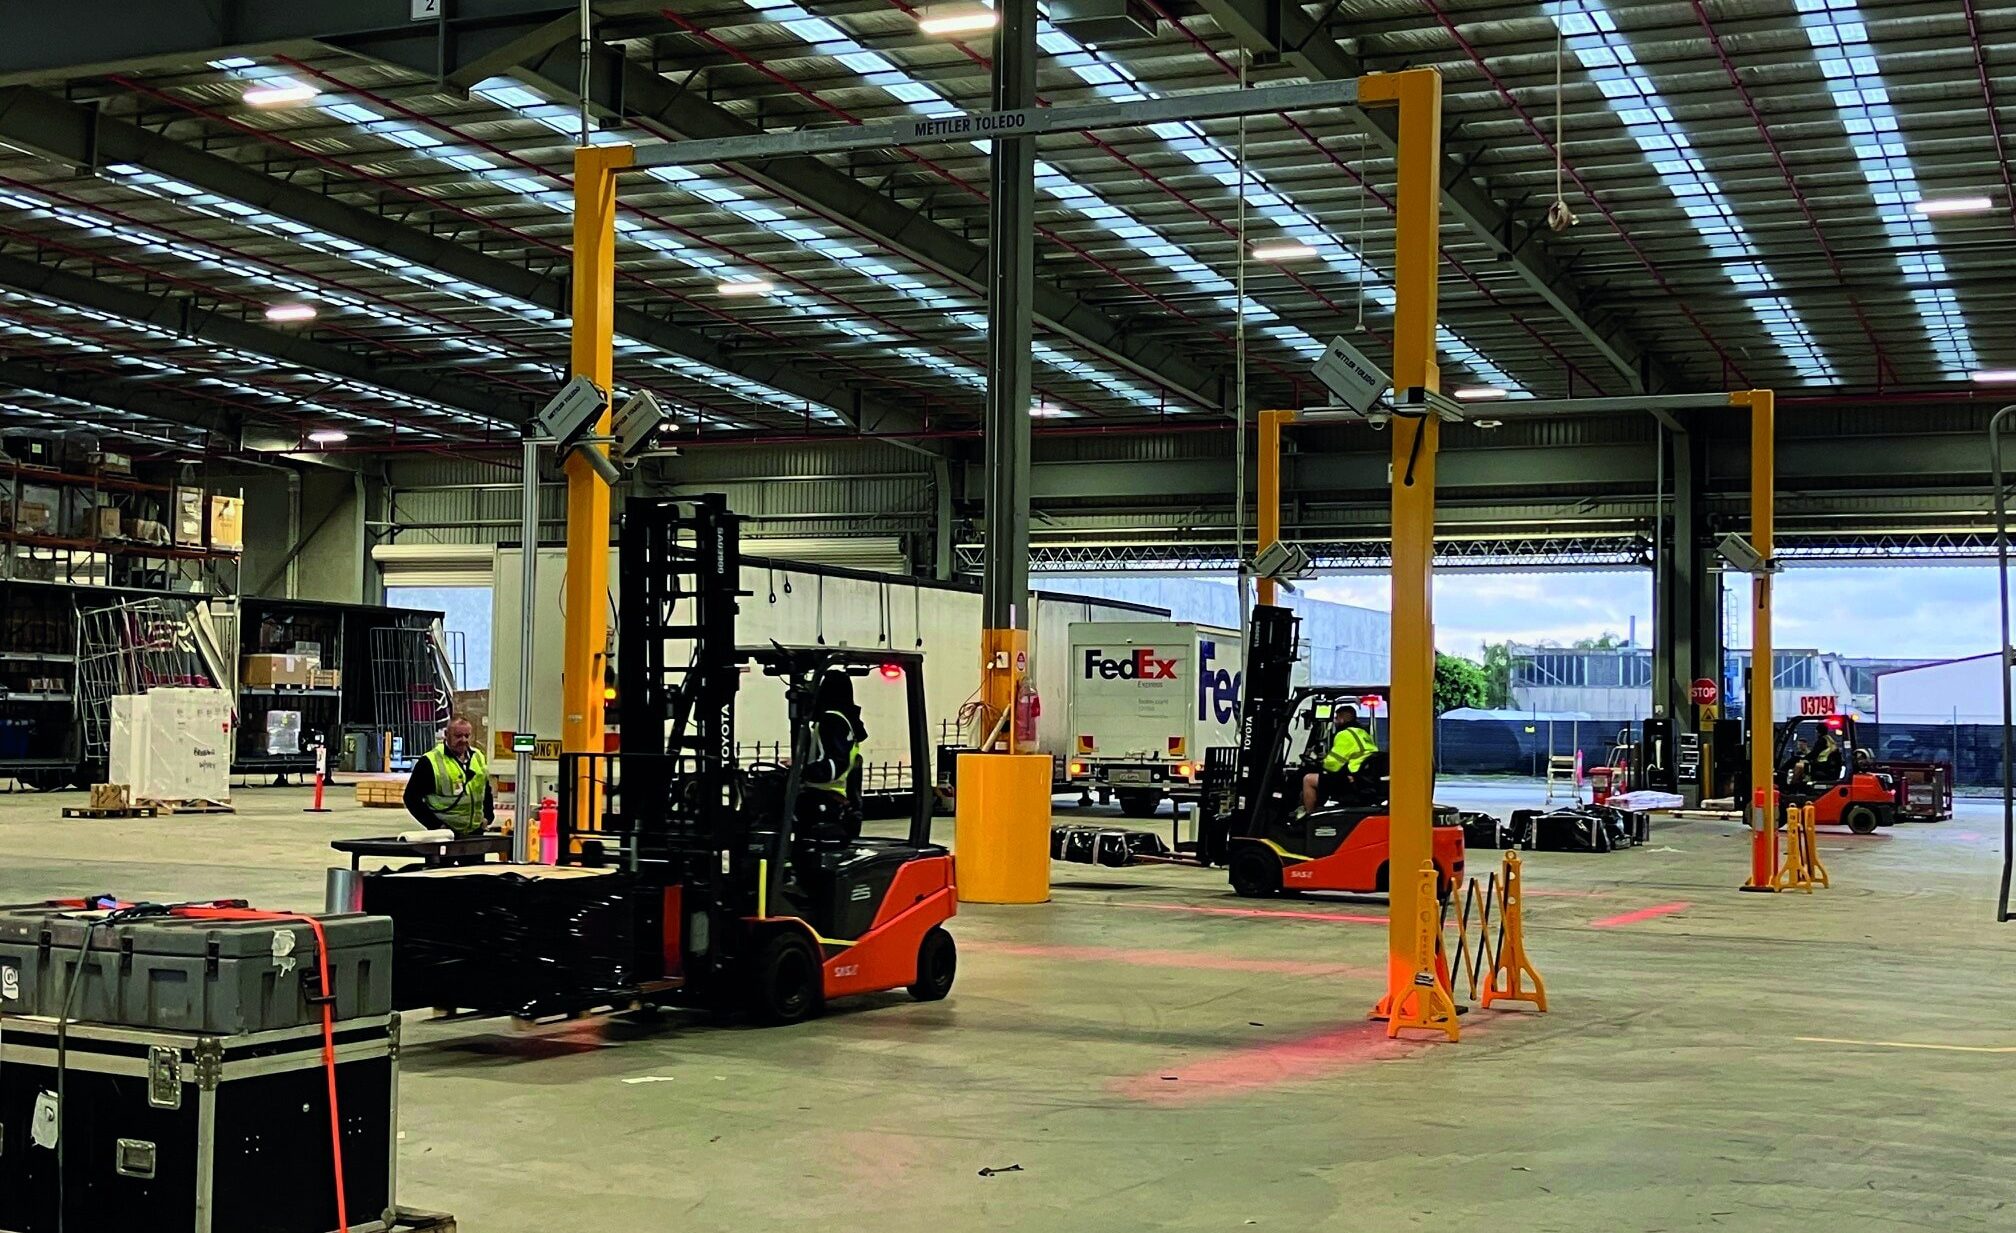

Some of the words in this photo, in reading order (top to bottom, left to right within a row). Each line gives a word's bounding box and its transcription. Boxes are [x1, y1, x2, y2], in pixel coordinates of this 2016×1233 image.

[915, 119, 970, 136] METTLER
[976, 114, 1025, 131] TOLEDO
[1334, 348, 1356, 369] METTLER
[1354, 366, 1376, 386] TOLEDO
[1085, 649, 1178, 680] FedEx
[1691, 687, 1716, 698] STOP
[1801, 695, 1836, 715] 03794
[721, 703, 730, 769] TOYOTA
[1243, 716, 1254, 751] TOYOTA
